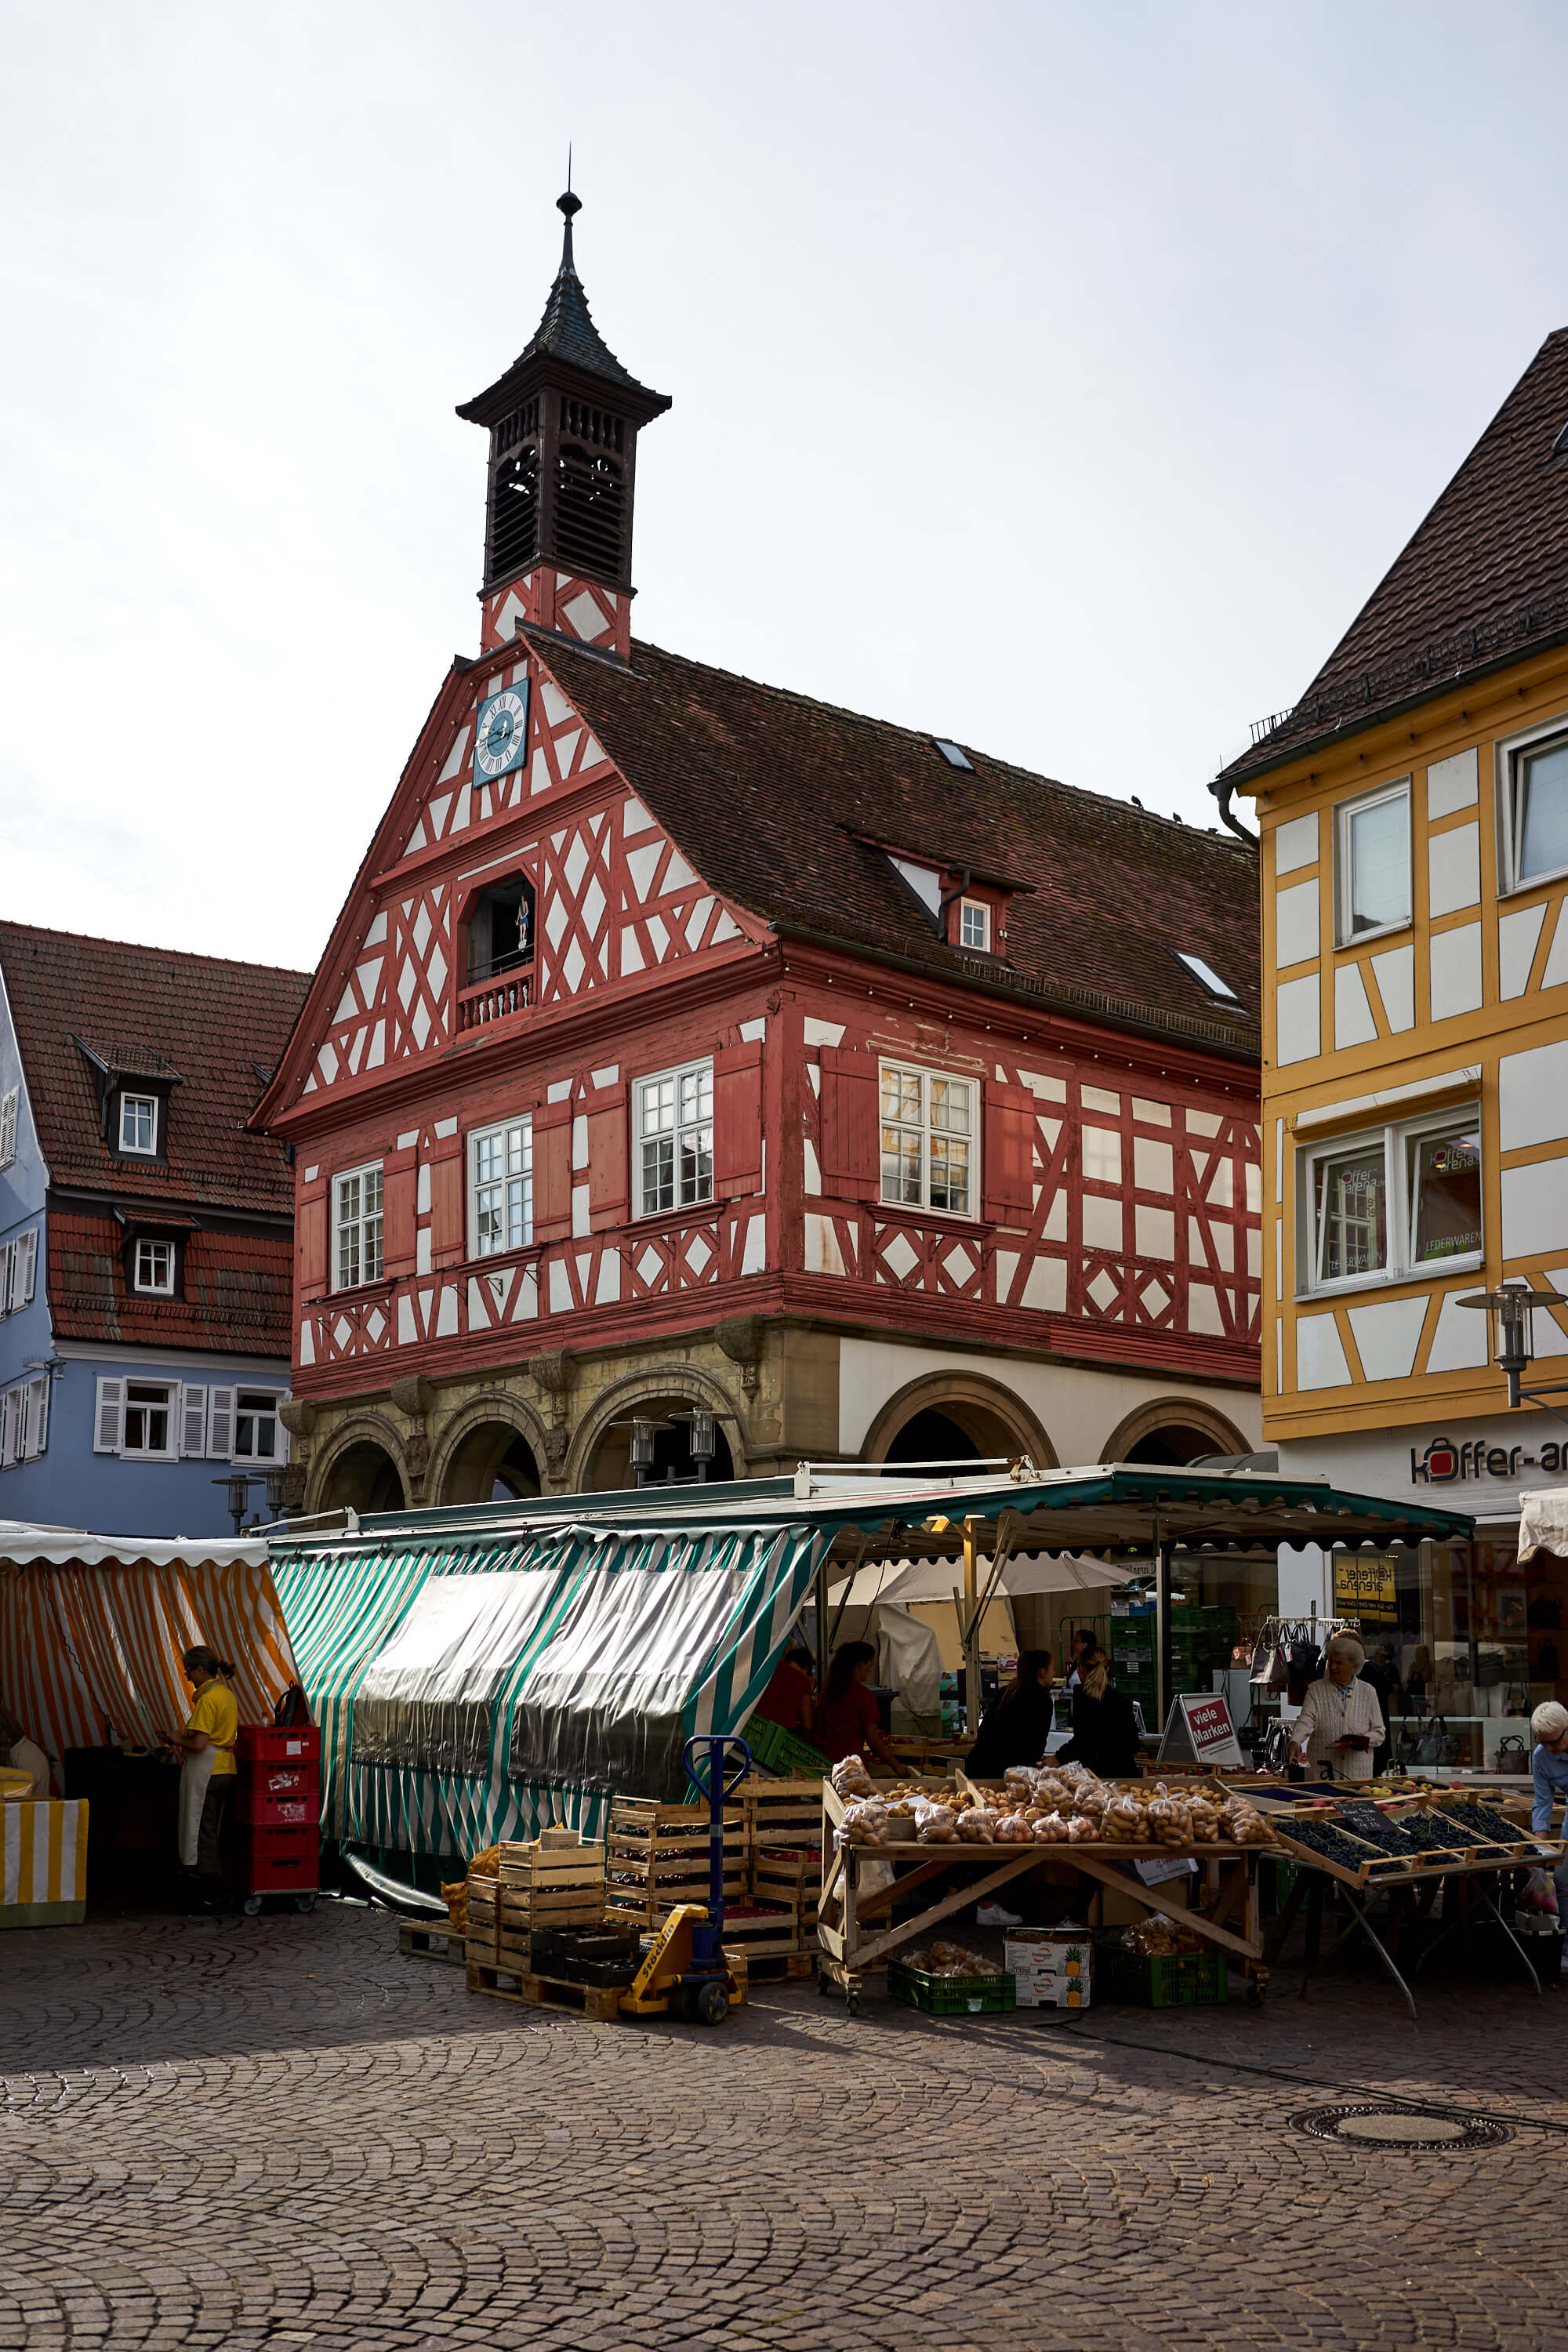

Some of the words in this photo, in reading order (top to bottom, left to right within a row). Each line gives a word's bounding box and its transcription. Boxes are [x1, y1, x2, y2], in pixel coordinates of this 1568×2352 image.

[489, 704, 497, 719] XI
[498, 695, 506, 712] XII
[514, 704, 522, 717] II
[514, 720, 524, 730] III
[1425, 1232, 1481, 1253] LEDERWAREN
[1331, 1250, 1382, 1270] LEERWAN
[1193, 1708, 1218, 1726] viele
[1192, 1722, 1230, 1744] Marken
[642, 1924, 675, 1978] Stöcklin
